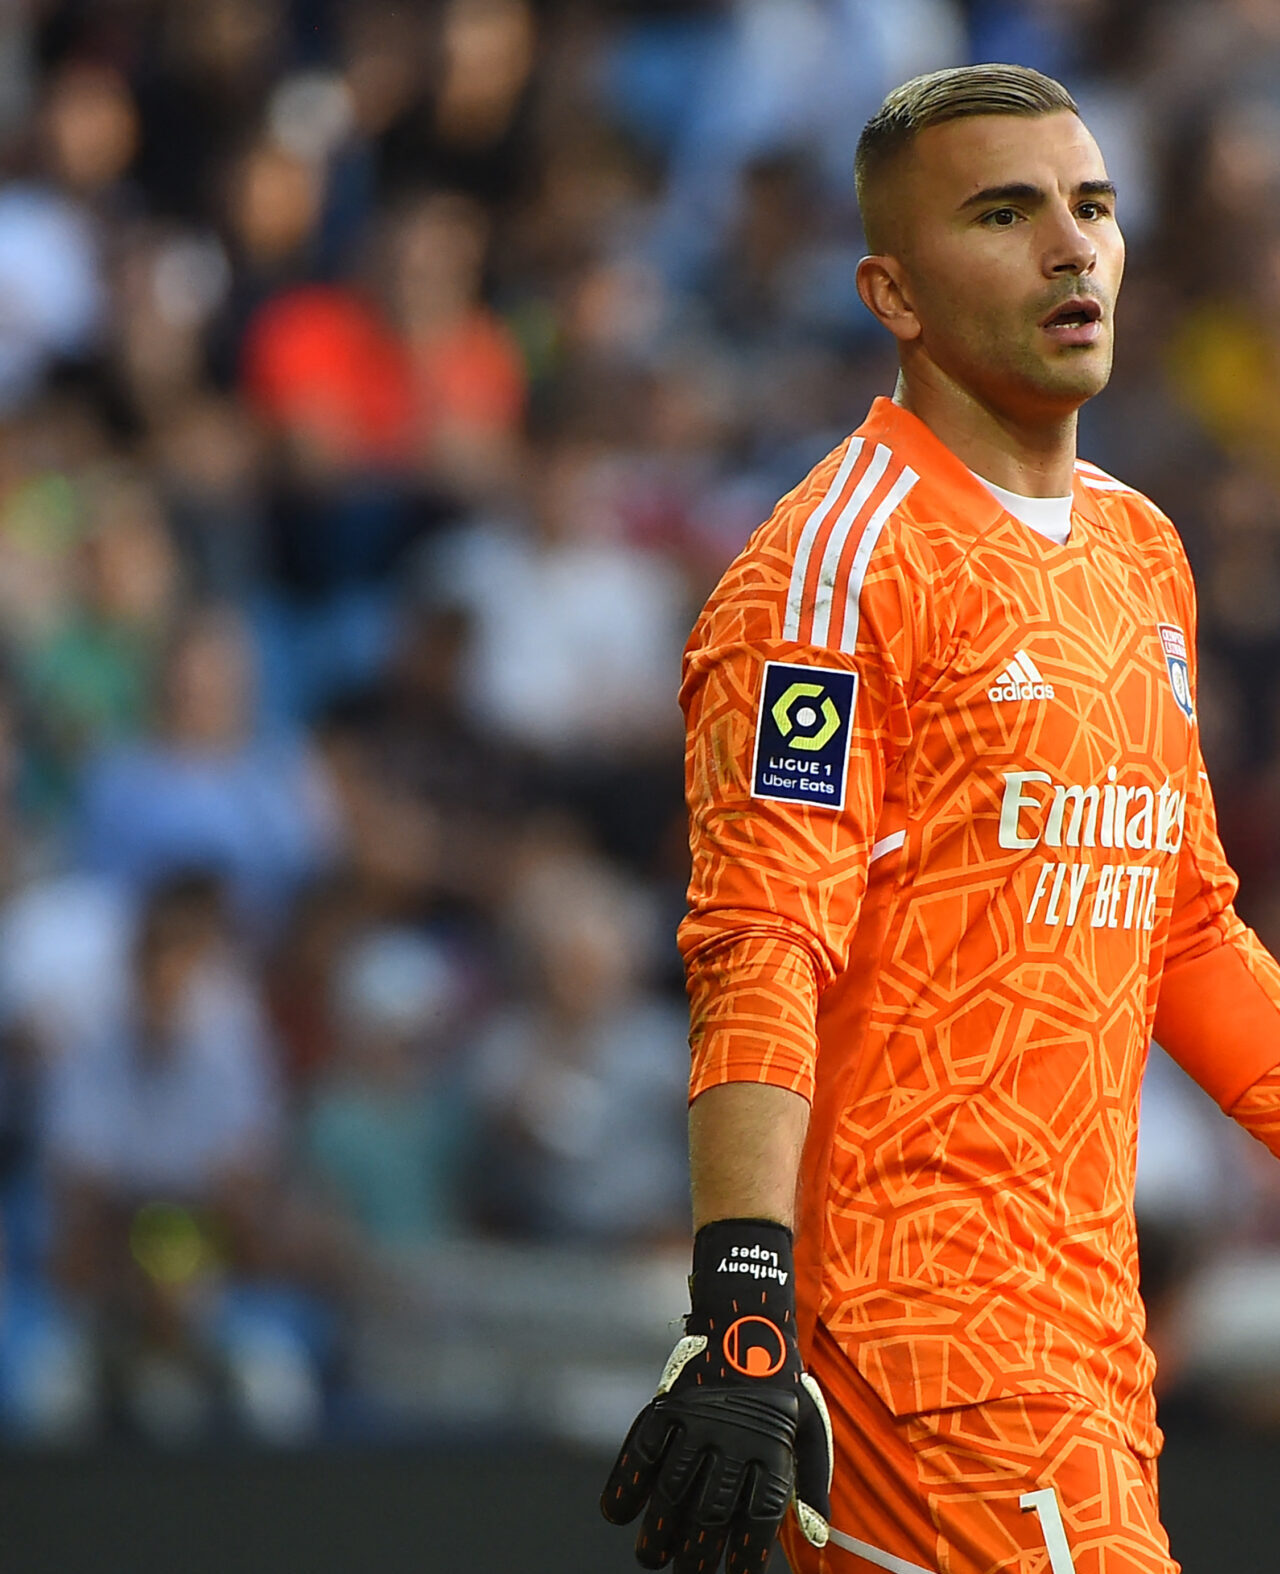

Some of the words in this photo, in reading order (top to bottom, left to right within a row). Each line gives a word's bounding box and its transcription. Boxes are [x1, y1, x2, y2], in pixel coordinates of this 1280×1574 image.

[988, 683, 1055, 702] adidas
[769, 757, 820, 775] LIGUE
[824, 763, 832, 776] 1
[762, 773, 797, 789] Uber
[799, 777, 835, 794] Eats
[1026, 862, 1090, 927] FLY
[1090, 864, 1160, 931] BETTE
[730, 1244, 779, 1268] Lopes
[717, 1257, 788, 1286] Anthony
[1019, 1487, 1077, 1574] 1
